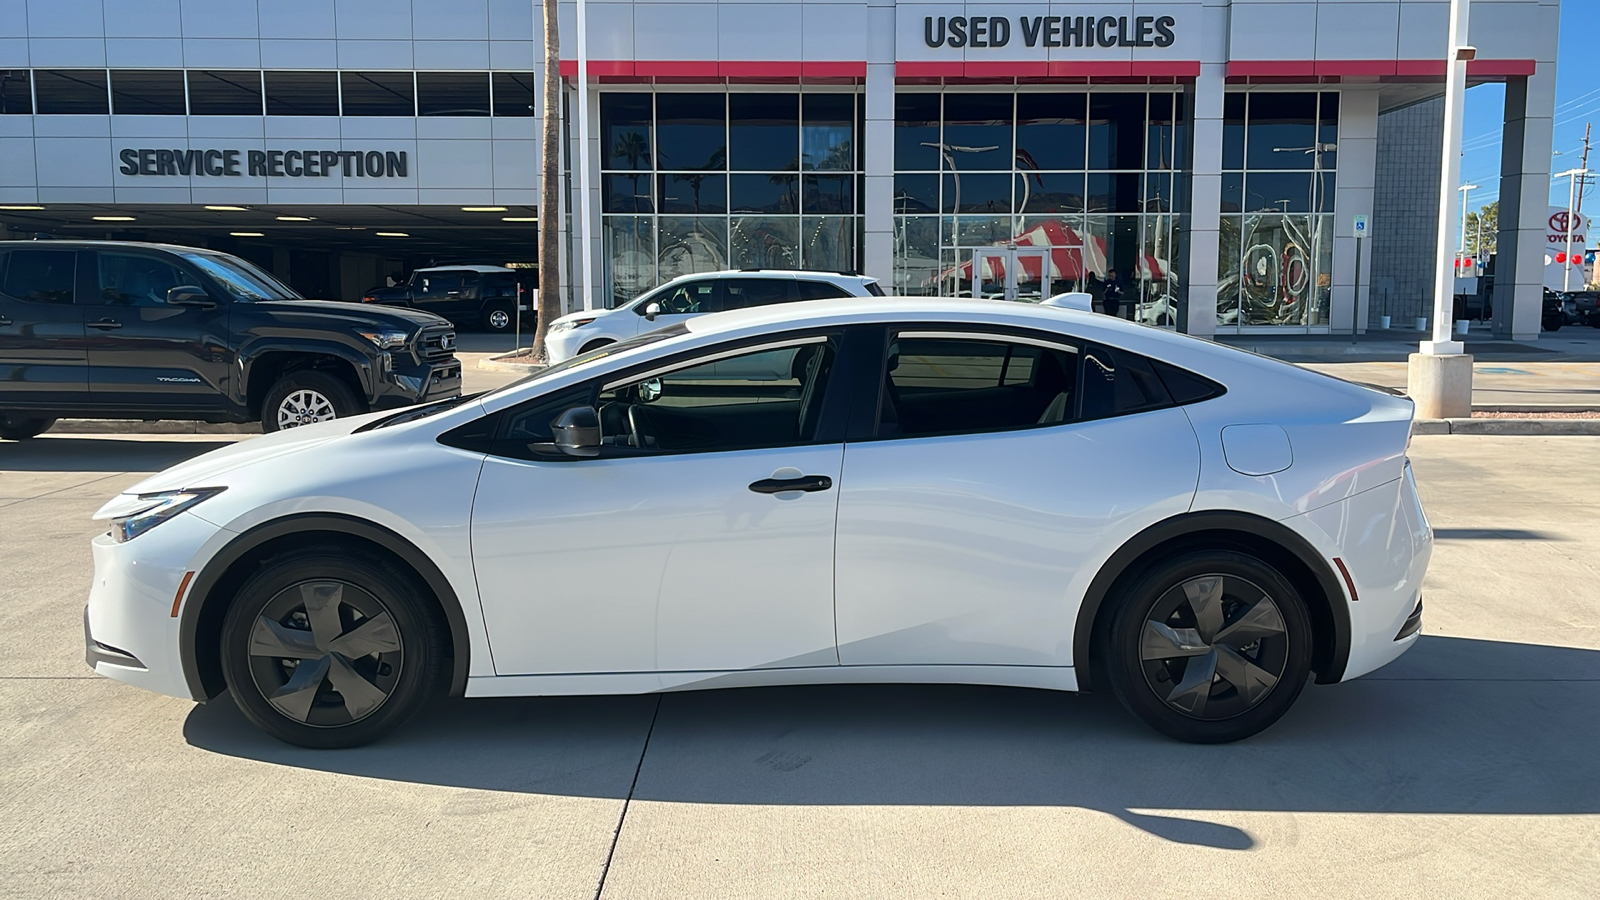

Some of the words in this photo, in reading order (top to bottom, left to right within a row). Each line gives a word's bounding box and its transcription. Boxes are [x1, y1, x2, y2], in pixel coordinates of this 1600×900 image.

[924, 16, 1011, 48] USED
[1020, 15, 1176, 48] VEHICLES
[119, 148, 242, 177] SERVICE
[247, 149, 408, 178] RECEPTION
[1546, 234, 1585, 243] OYOTA
